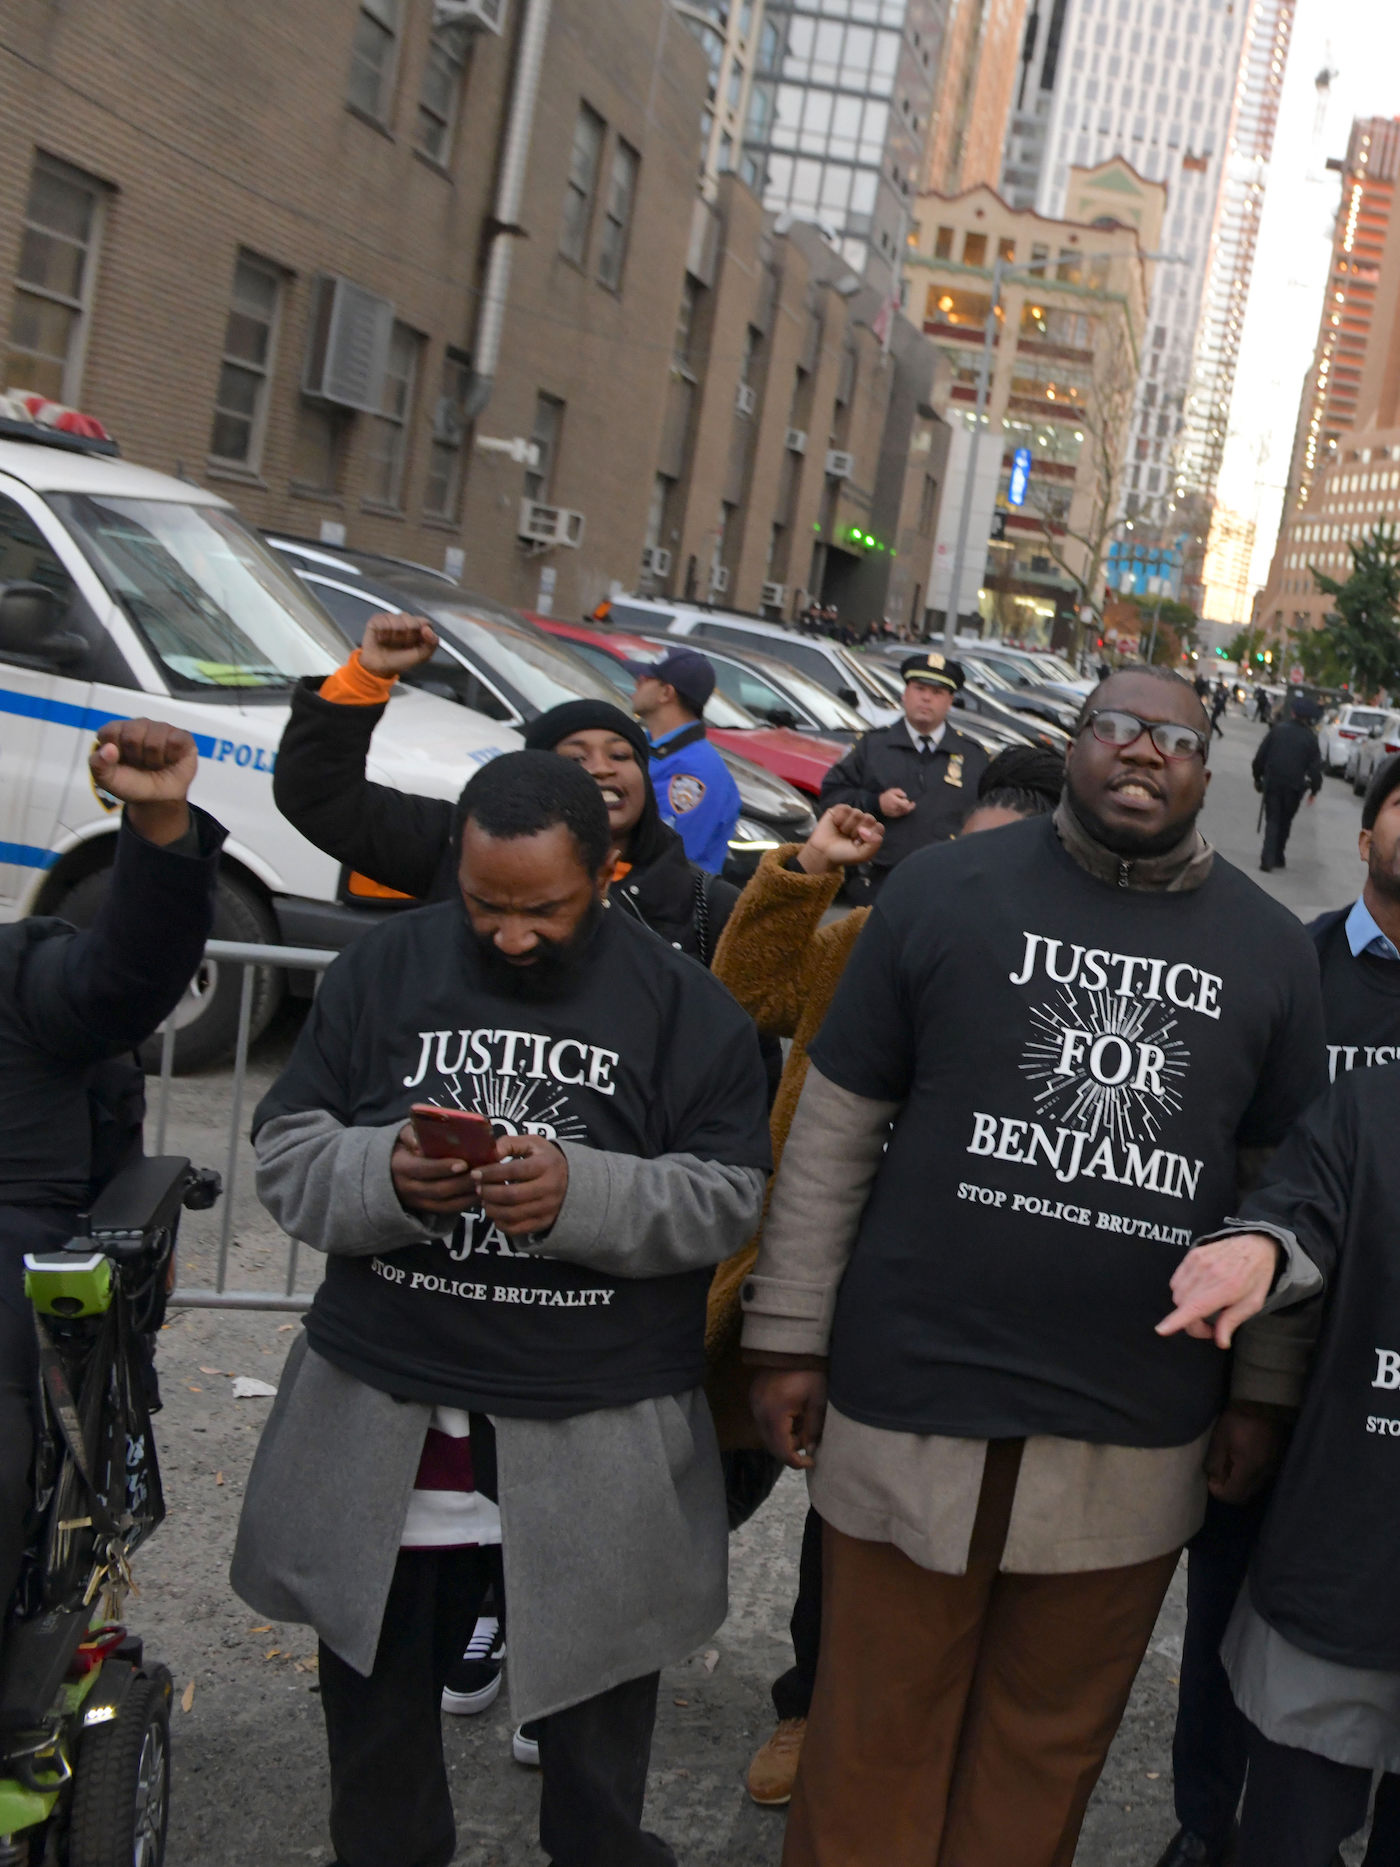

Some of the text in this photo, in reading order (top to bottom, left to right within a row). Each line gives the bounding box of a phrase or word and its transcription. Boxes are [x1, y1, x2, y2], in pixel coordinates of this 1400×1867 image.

[216, 739, 279, 775] POLI
[1008, 931, 1224, 1020] JUSTICE
[403, 1029, 620, 1096] JUSTICE
[1053, 1026, 1166, 1096] FOR
[966, 1112, 1204, 1200] BENJAMIN
[957, 1182, 1193, 1247] STOP POLICE BRUTALITY
[371, 1256, 615, 1306] STOP POLICE BRUTALITY
